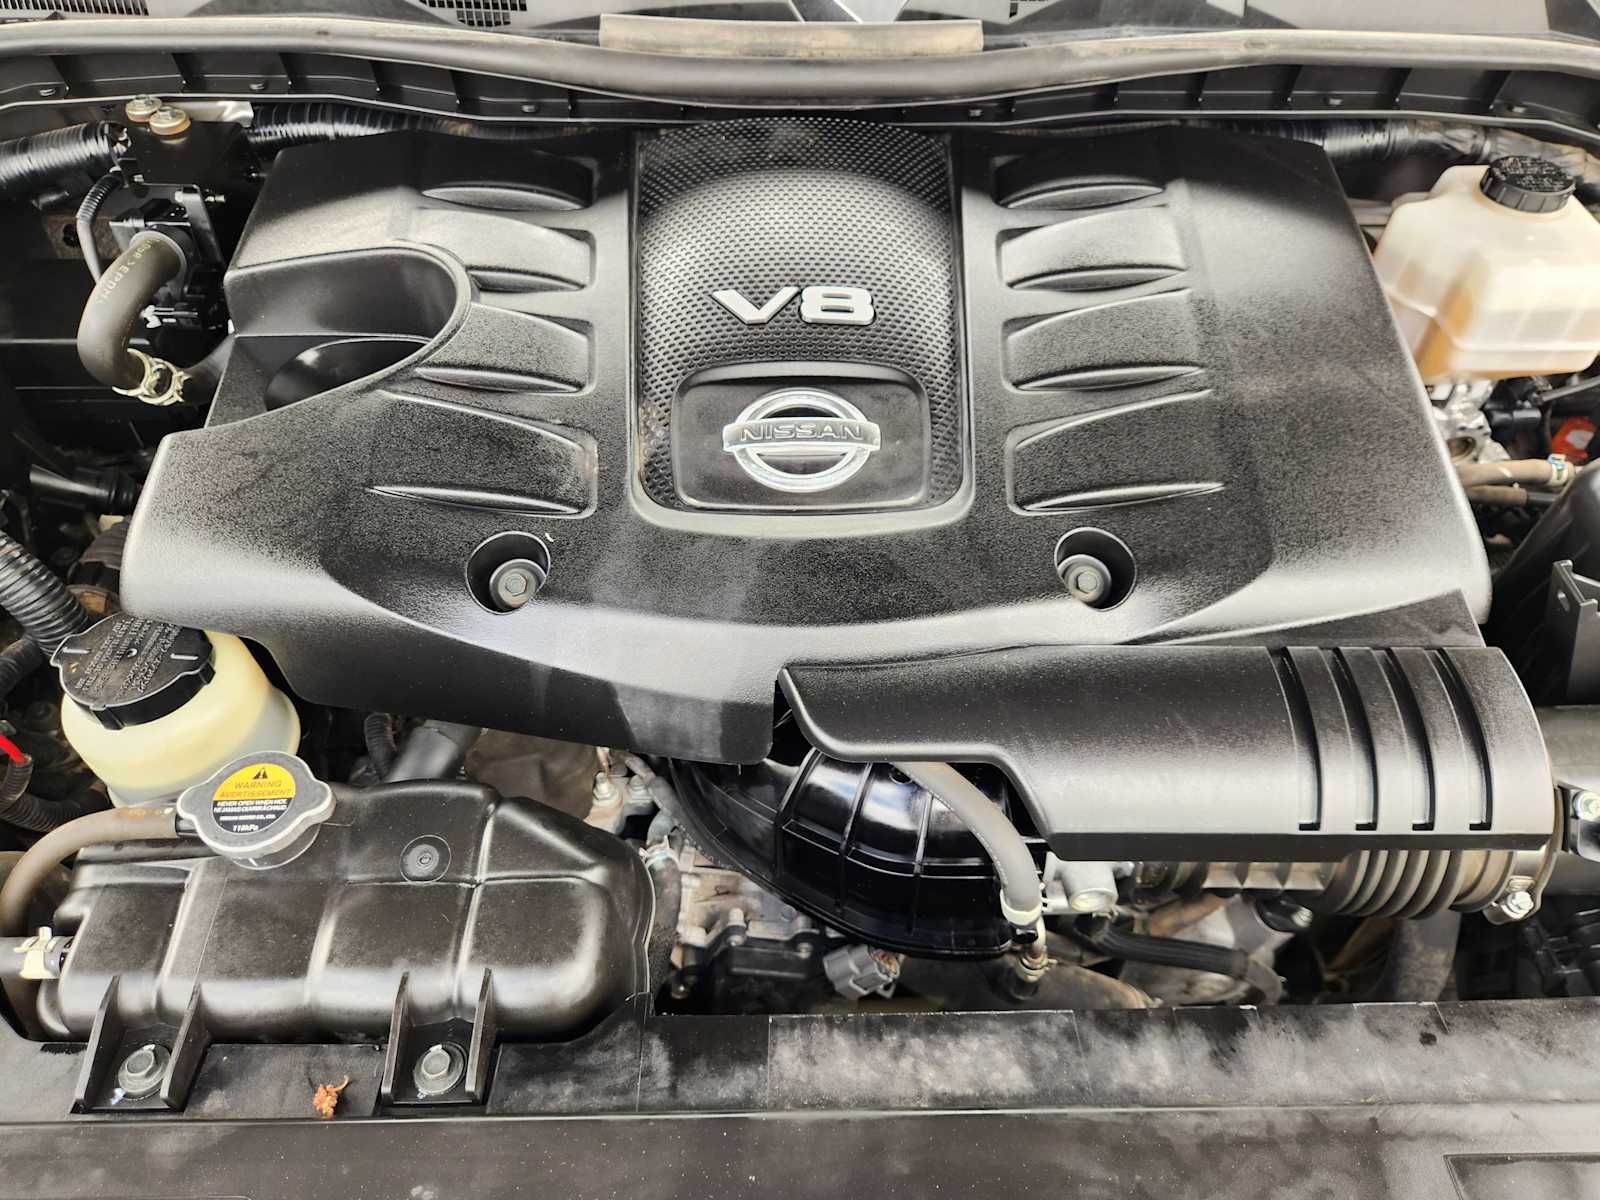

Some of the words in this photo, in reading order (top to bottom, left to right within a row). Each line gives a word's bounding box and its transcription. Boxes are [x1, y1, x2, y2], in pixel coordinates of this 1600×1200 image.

[711, 285, 875, 326] V8
[740, 423, 865, 442] NISSAN
[220, 789, 293, 798] AVERTISSEMENT
